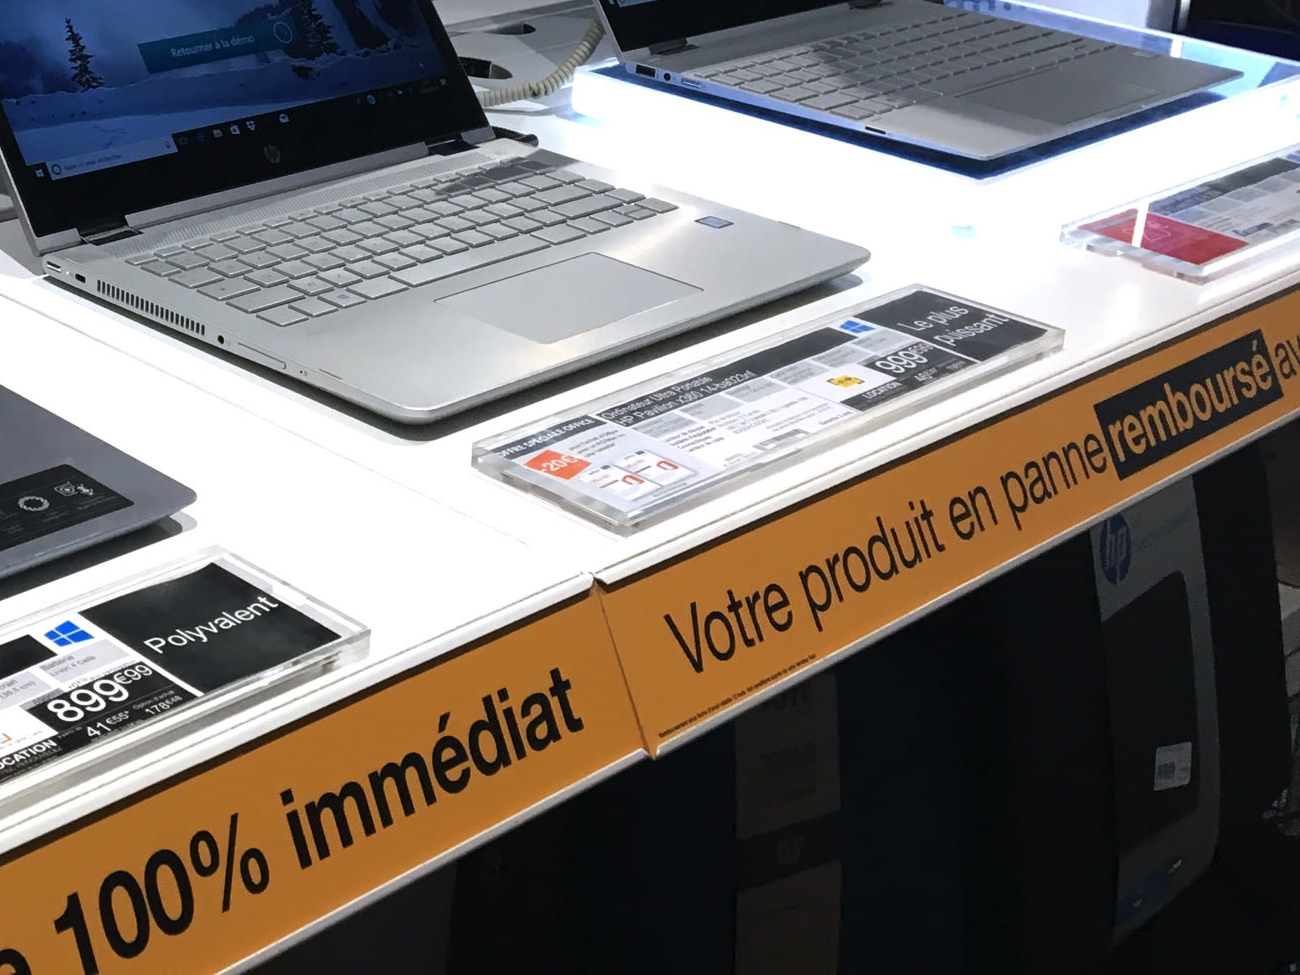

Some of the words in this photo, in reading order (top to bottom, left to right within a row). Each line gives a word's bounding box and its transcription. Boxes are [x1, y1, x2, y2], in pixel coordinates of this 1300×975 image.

[170, 42, 213, 57] Retourner
[230, 35, 255, 46] démo
[896, 319, 928, 332] Le
[927, 304, 969, 328] plus
[933, 311, 1011, 346] puissant
[651, 386, 676, 402] Ultra
[675, 375, 713, 393] Portable
[562, 418, 596, 436] OFFICE
[616, 415, 634, 426] HP
[635, 399, 678, 419] Pavilion
[664, 581, 793, 674] Votre
[799, 500, 946, 632] produit
[949, 483, 999, 540] en
[1001, 430, 1108, 530] panne
[1108, 340, 1273, 462] remboursé
[1274, 335, 1300, 380] a
[143, 595, 279, 654] Polyvalent
[47, 664, 153, 722] 899€99
[54, 813, 270, 962] 100%
[281, 666, 586, 870] immédiat
